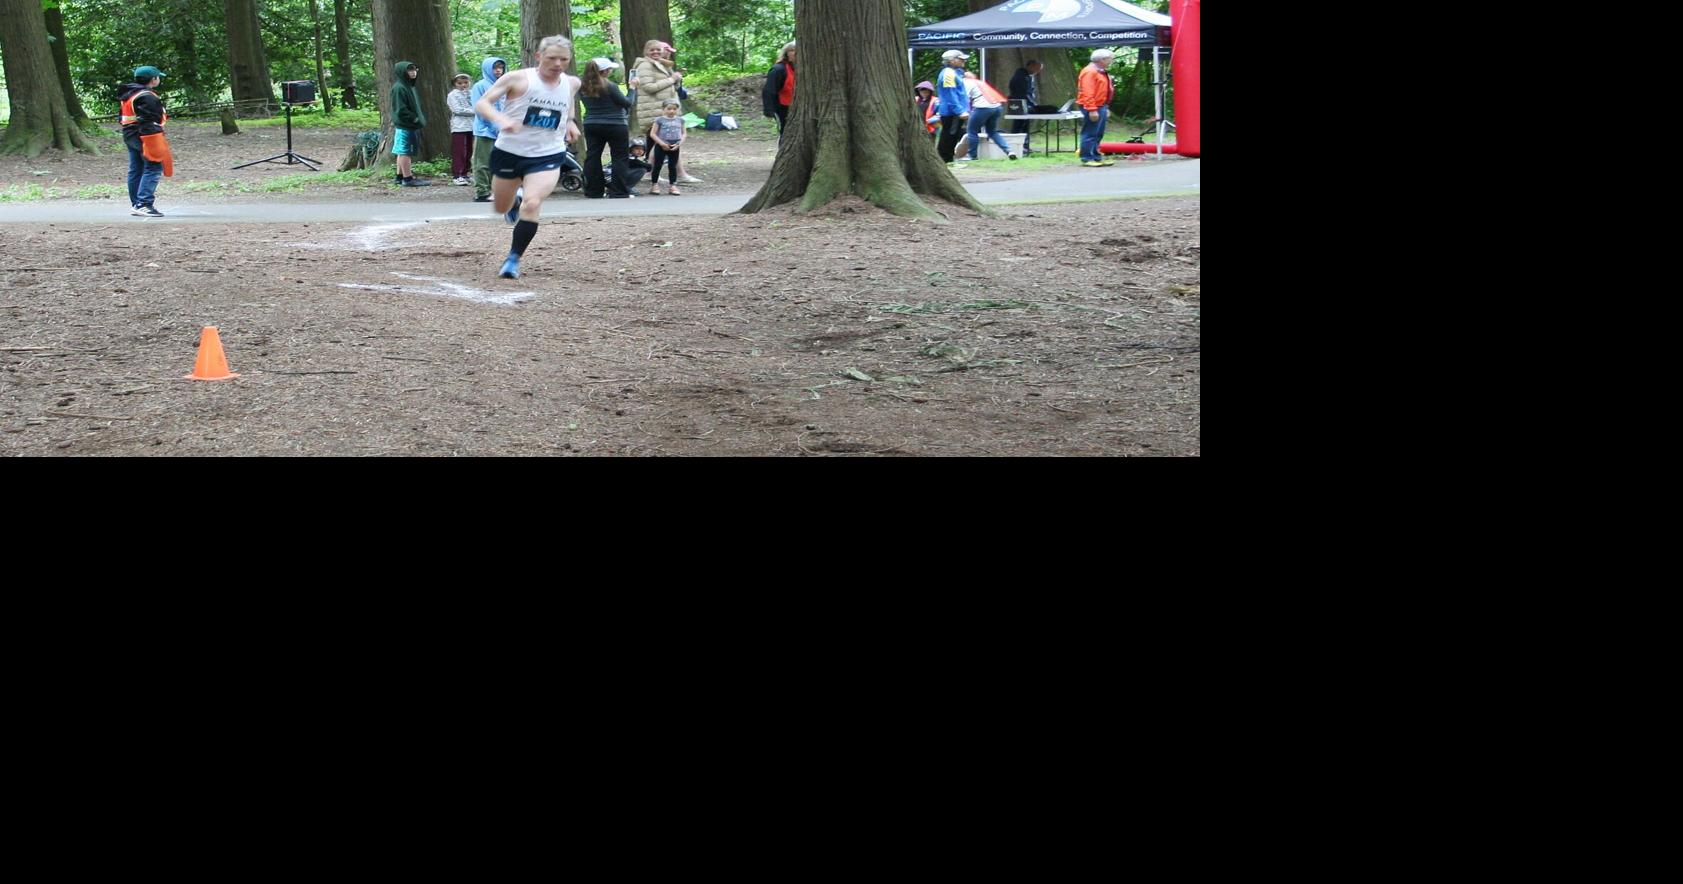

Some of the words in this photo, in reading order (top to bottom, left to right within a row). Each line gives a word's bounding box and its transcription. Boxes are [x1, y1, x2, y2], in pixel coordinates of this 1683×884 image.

[917, 32, 966, 40] PACIFIC
[973, 32, 1028, 42] Community,
[1029, 31, 1087, 40] Connection,
[1088, 31, 1148, 41] Competition
[528, 114, 556, 128] 1201
